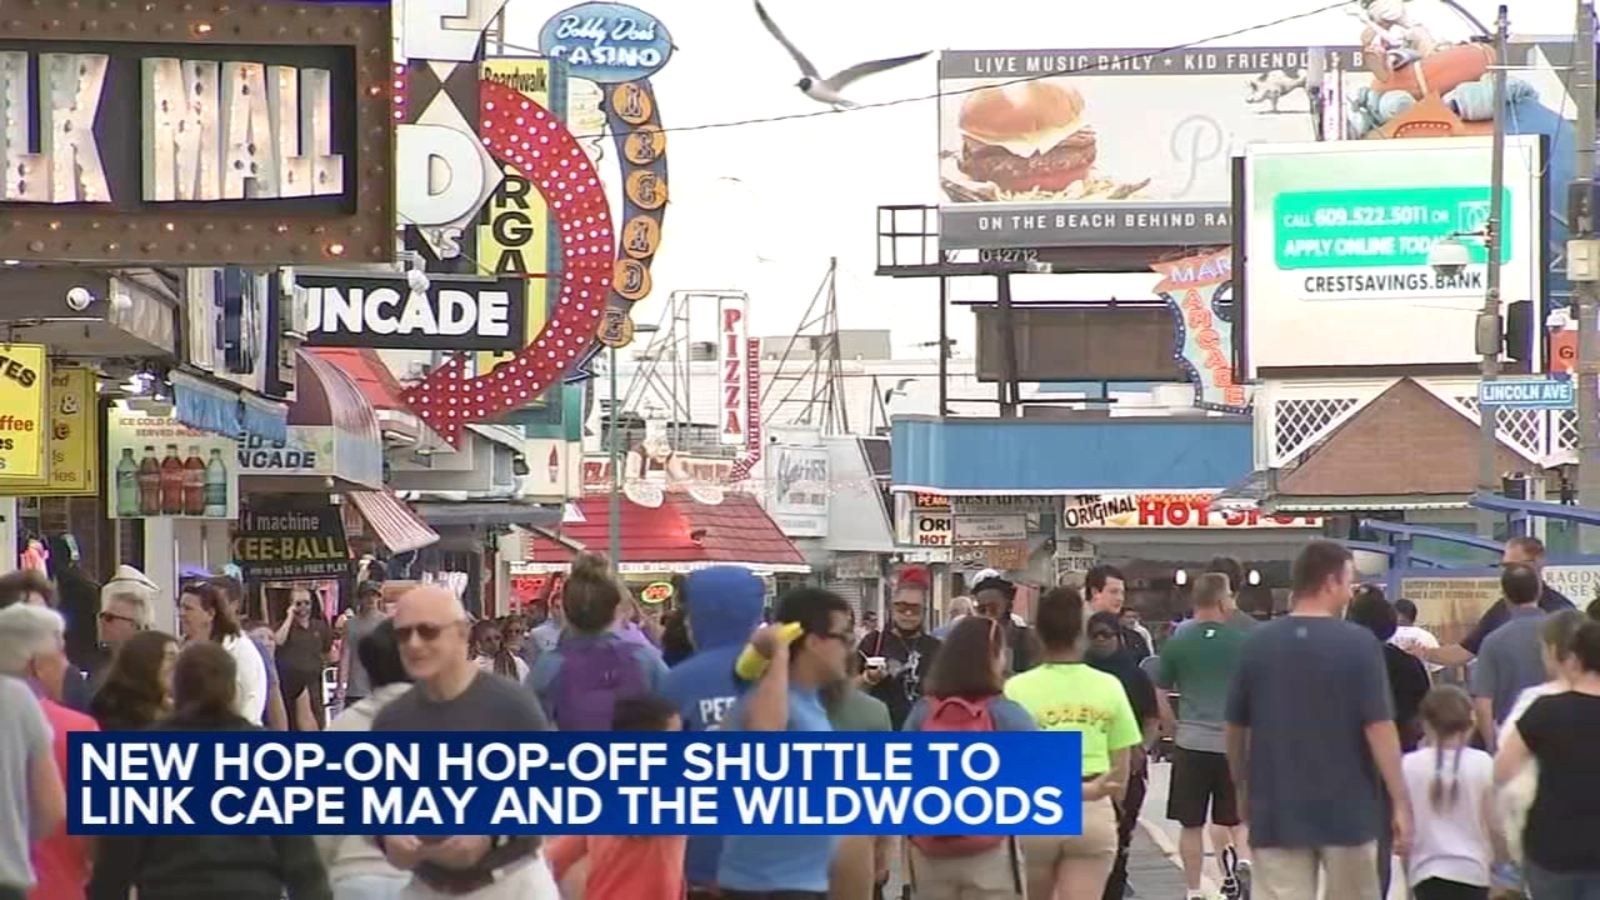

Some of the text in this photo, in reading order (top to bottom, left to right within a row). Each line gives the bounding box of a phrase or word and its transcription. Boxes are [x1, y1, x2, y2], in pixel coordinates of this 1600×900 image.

[550, 45, 661, 66] CASINO
[974, 57, 1016, 73] LIVE
[1026, 55, 1089, 72] MUSIC
[1099, 55, 1153, 71] DAILY
[1184, 53, 1216, 70] KID
[1227, 51, 1308, 69] FRIENDL
[141, 58, 344, 201] MALL
[979, 212, 1231, 230] ON THE BEACH BEHIND RA
[1283, 215, 1312, 228] CALL
[1284, 238, 1332, 257] APPLY
[1334, 236, 1395, 256] ONLINE
[1304, 271, 1482, 292] CRESTSAVINGS.BANK
[1181, 288, 1246, 406] ARCADE
[723, 308, 742, 435] PIZZA
[1483, 384, 1572, 401] LINCOLN AVE
[257, 511, 320, 531] machine
[1066, 496, 1136, 527] ORIGINAL
[1139, 502, 1212, 526] HOT
[919, 534, 947, 545] HOT
